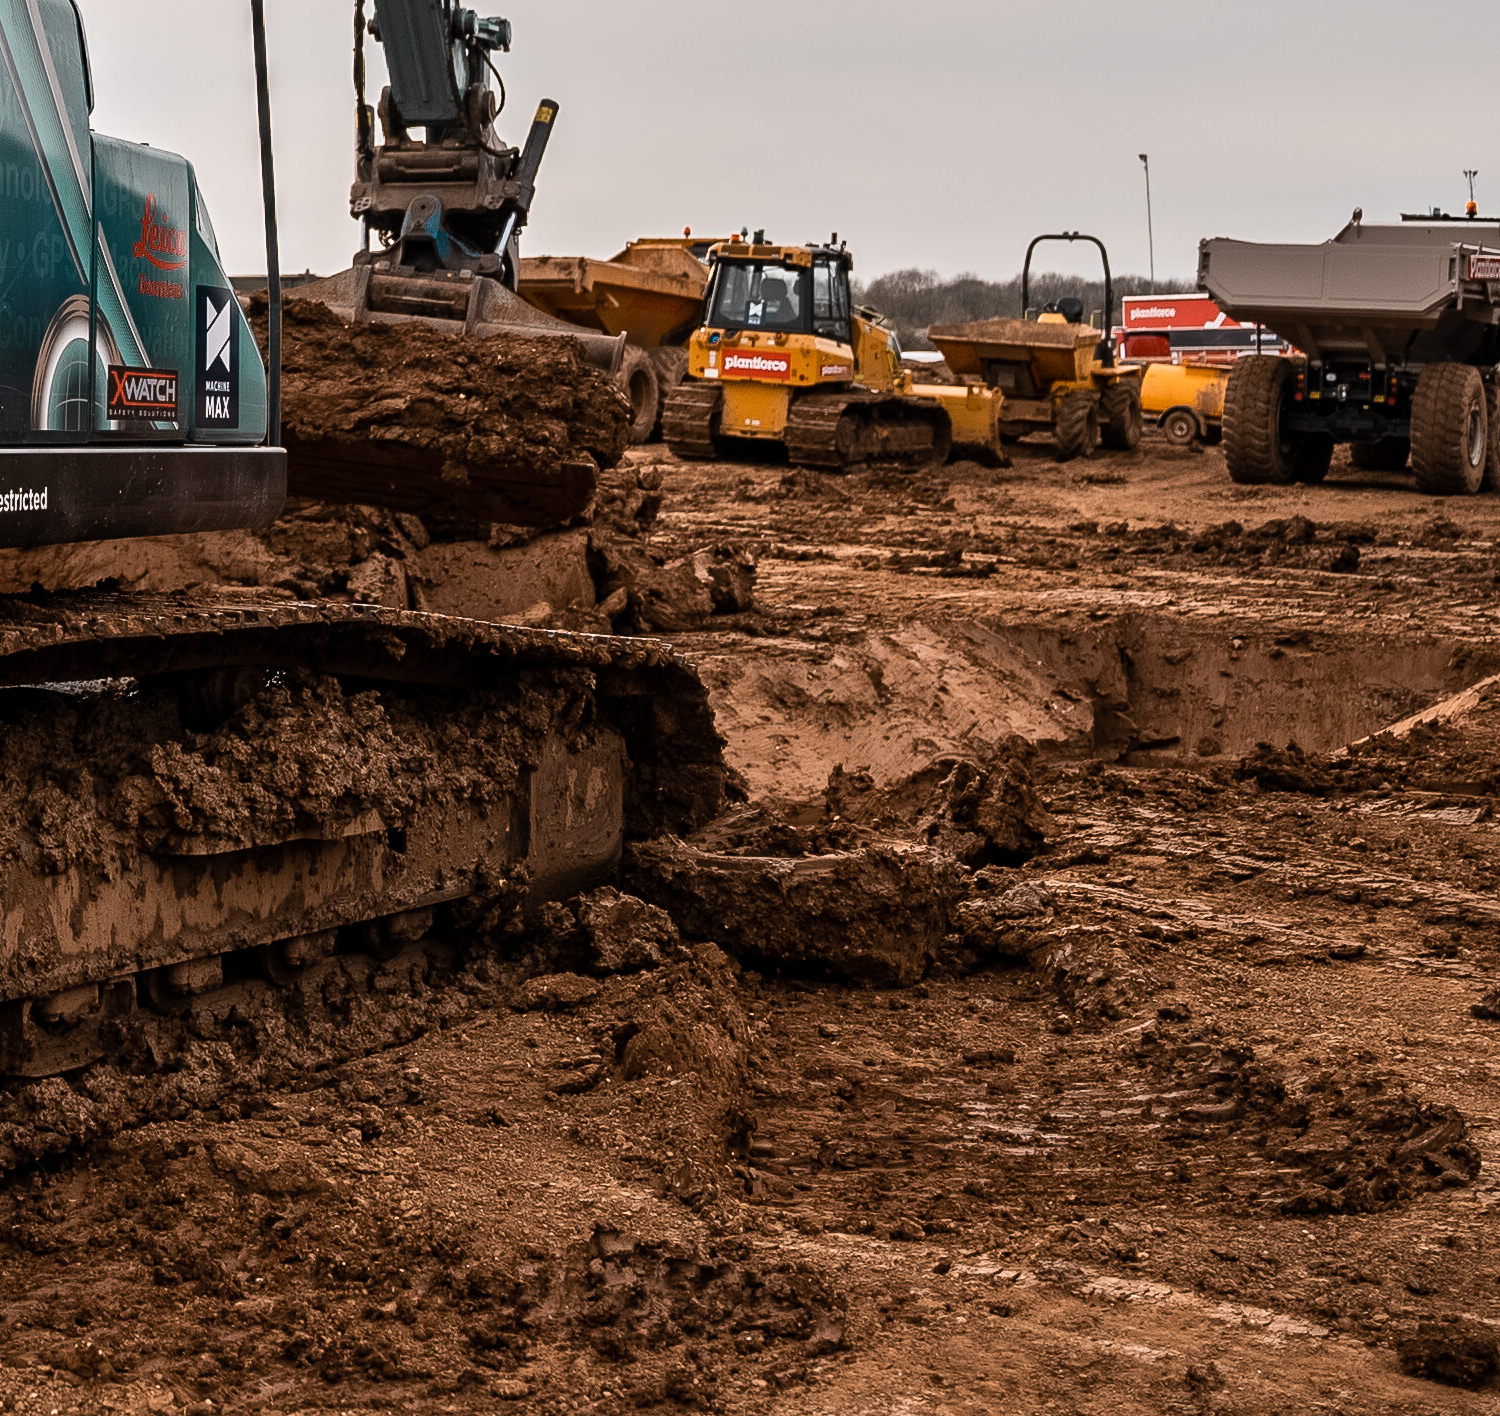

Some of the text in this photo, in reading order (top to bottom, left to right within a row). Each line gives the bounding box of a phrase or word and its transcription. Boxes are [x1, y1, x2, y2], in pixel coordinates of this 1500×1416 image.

[133, 191, 188, 271] Leica
[724, 355, 787, 372] plantforce
[111, 371, 176, 408] XWATCH
[205, 380, 230, 392] MACHINE
[205, 396, 230, 419] MAX
